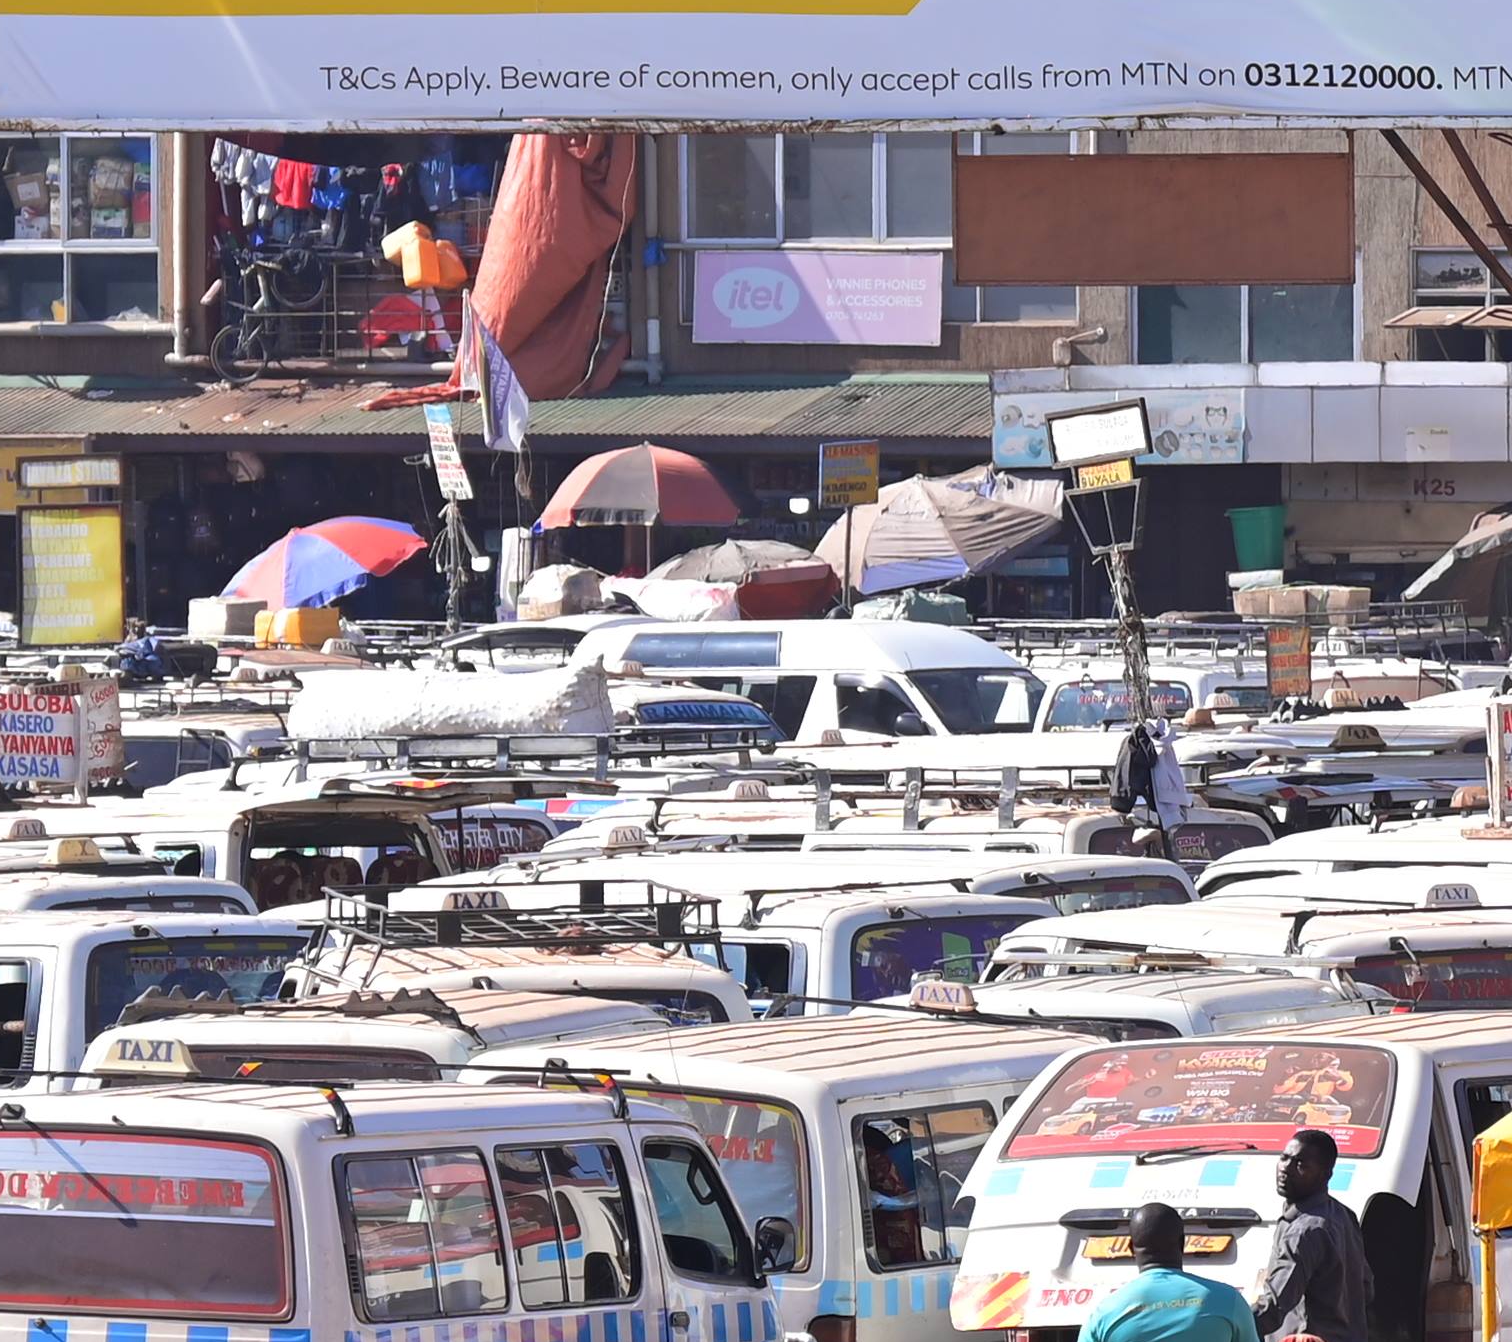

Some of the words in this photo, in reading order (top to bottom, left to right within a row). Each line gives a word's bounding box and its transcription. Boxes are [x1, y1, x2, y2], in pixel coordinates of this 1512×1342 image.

[321, 66, 396, 92] T&Cs
[405, 66, 491, 96] Apply.
[501, 65, 610, 92] Beware
[619, 63, 651, 90] of
[656, 66, 784, 95] conmen,
[791, 65, 853, 97] only
[860, 66, 959, 97] accept
[967, 64, 1033, 91] calls
[1040, 61, 1112, 89] from
[1120, 61, 1188, 87] MTN
[1198, 67, 1236, 87] on
[1244, 62, 1443, 90] 0312120000.
[728, 279, 784, 311] itel
[875, 279, 926, 291] PHONES
[1413, 479, 1455, 497] K25
[448, 891, 498, 909] TAXI
[918, 986, 960, 1004] TAXI
[117, 1039, 175, 1063] TAXI
